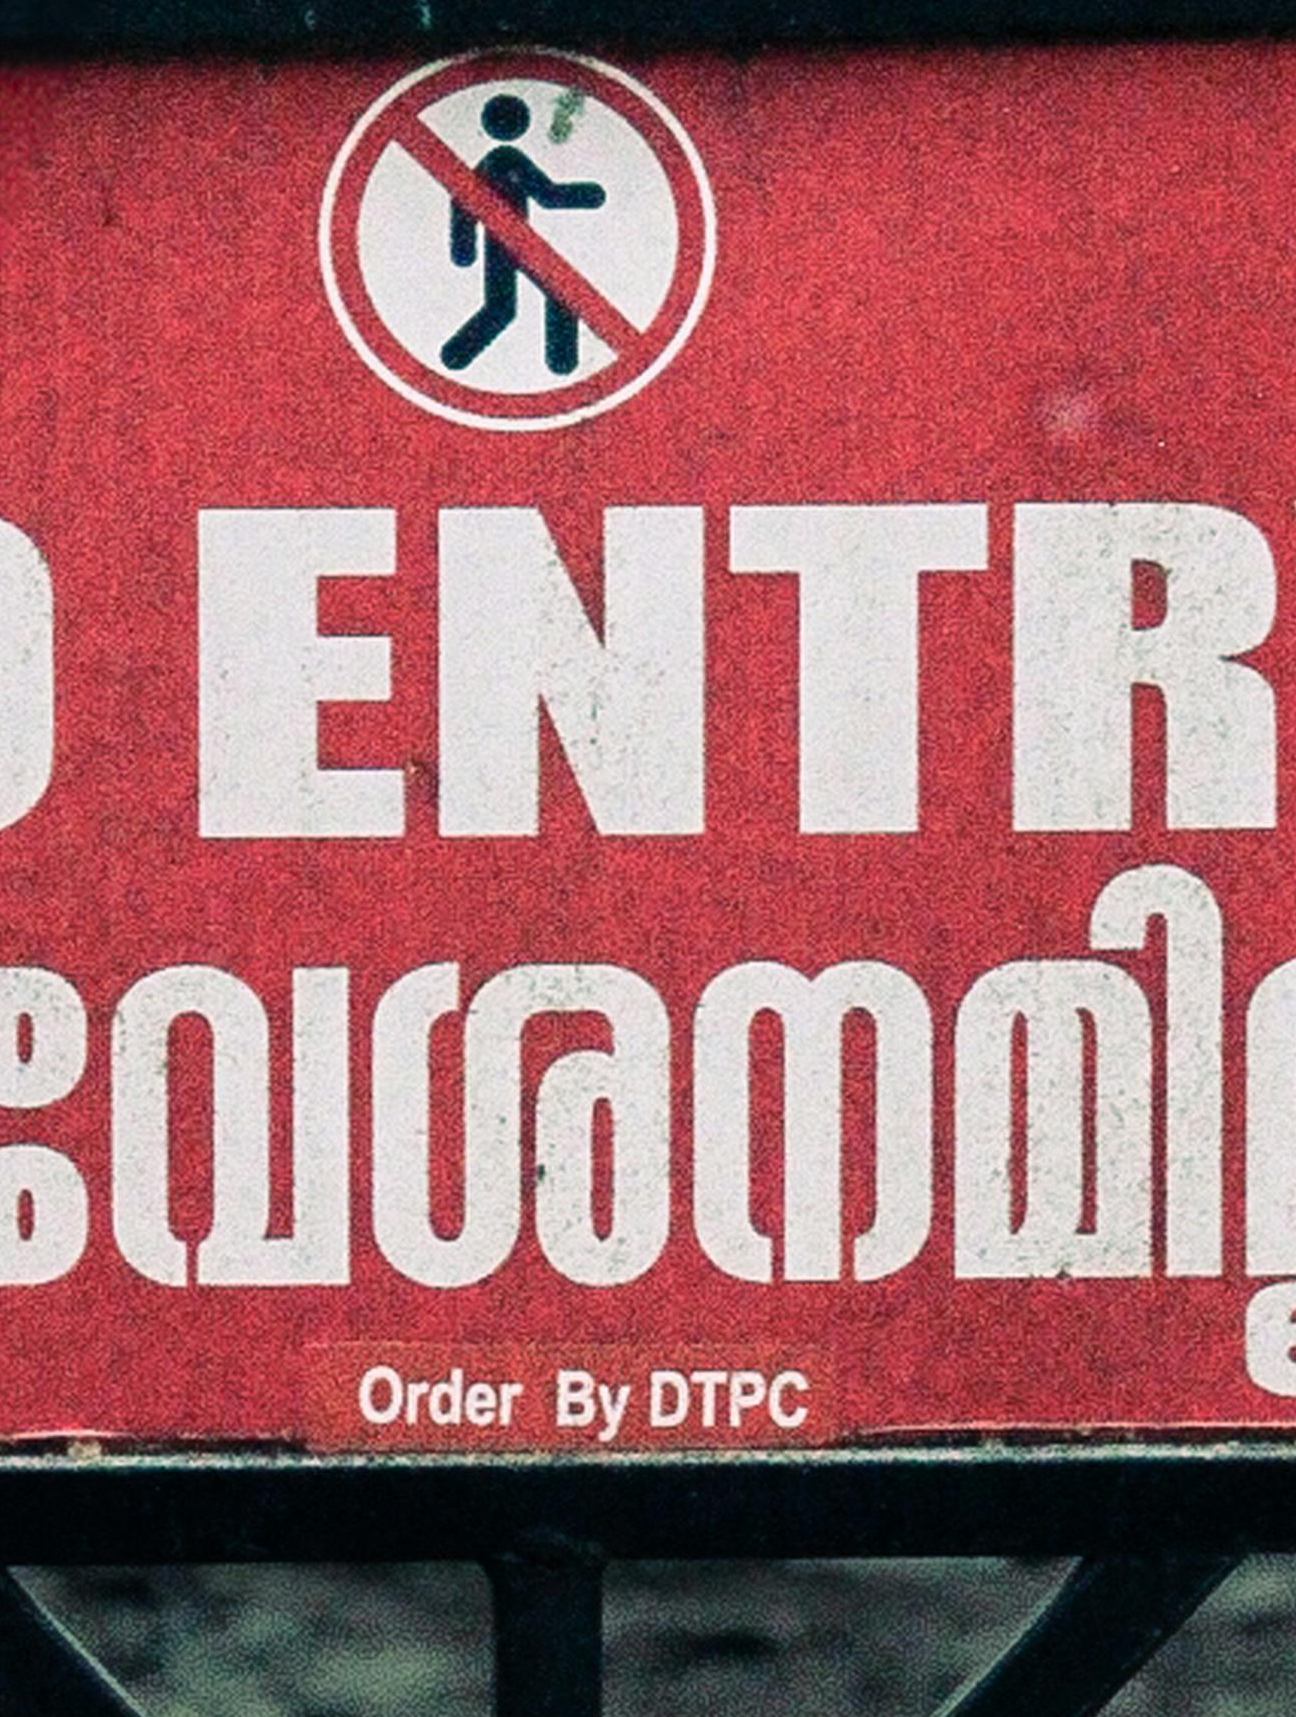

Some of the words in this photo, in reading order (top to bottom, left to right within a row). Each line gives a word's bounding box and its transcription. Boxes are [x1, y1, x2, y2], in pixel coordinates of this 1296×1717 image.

[358, 1365, 523, 1425] Order
[556, 1369, 631, 1441] By
[650, 1370, 809, 1427] DTPC
